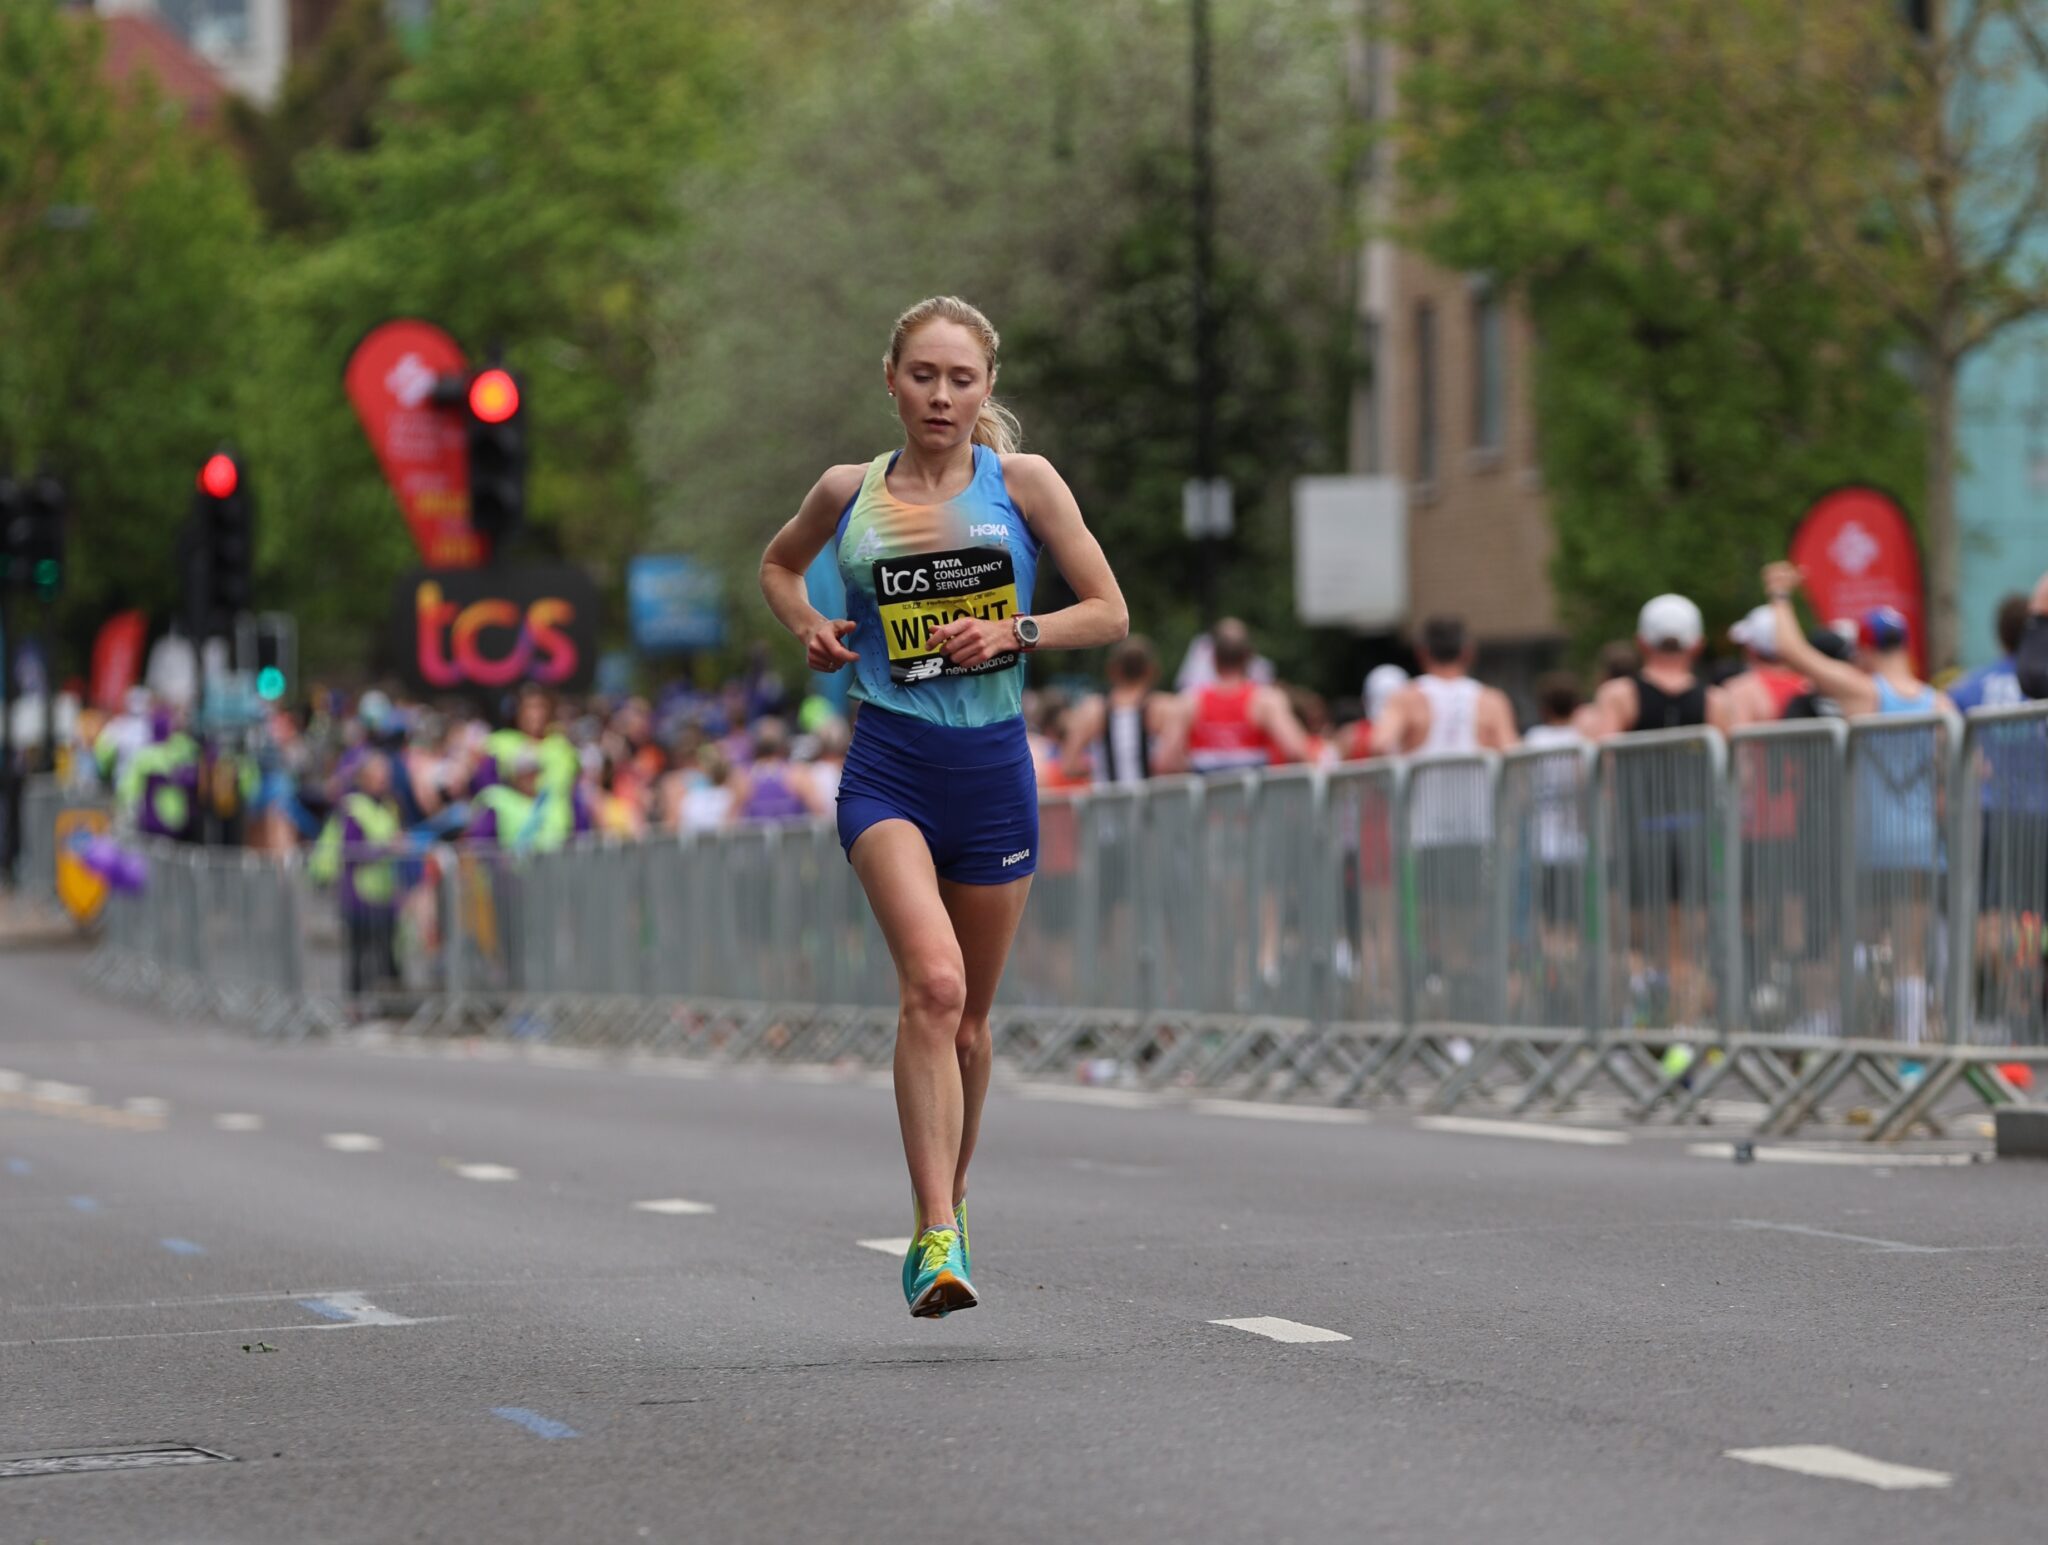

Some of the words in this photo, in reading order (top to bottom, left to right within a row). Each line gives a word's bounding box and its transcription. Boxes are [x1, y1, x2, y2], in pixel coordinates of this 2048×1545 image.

[969, 523, 1009, 537] HOKA
[932, 558, 963, 570] TATA
[933, 560, 1003, 581] CONSULTANCY
[881, 566, 930, 596] tcs
[935, 576, 980, 592] SERVICES
[416, 578, 579, 689] tcs
[1002, 848, 1030, 867] HOKA
